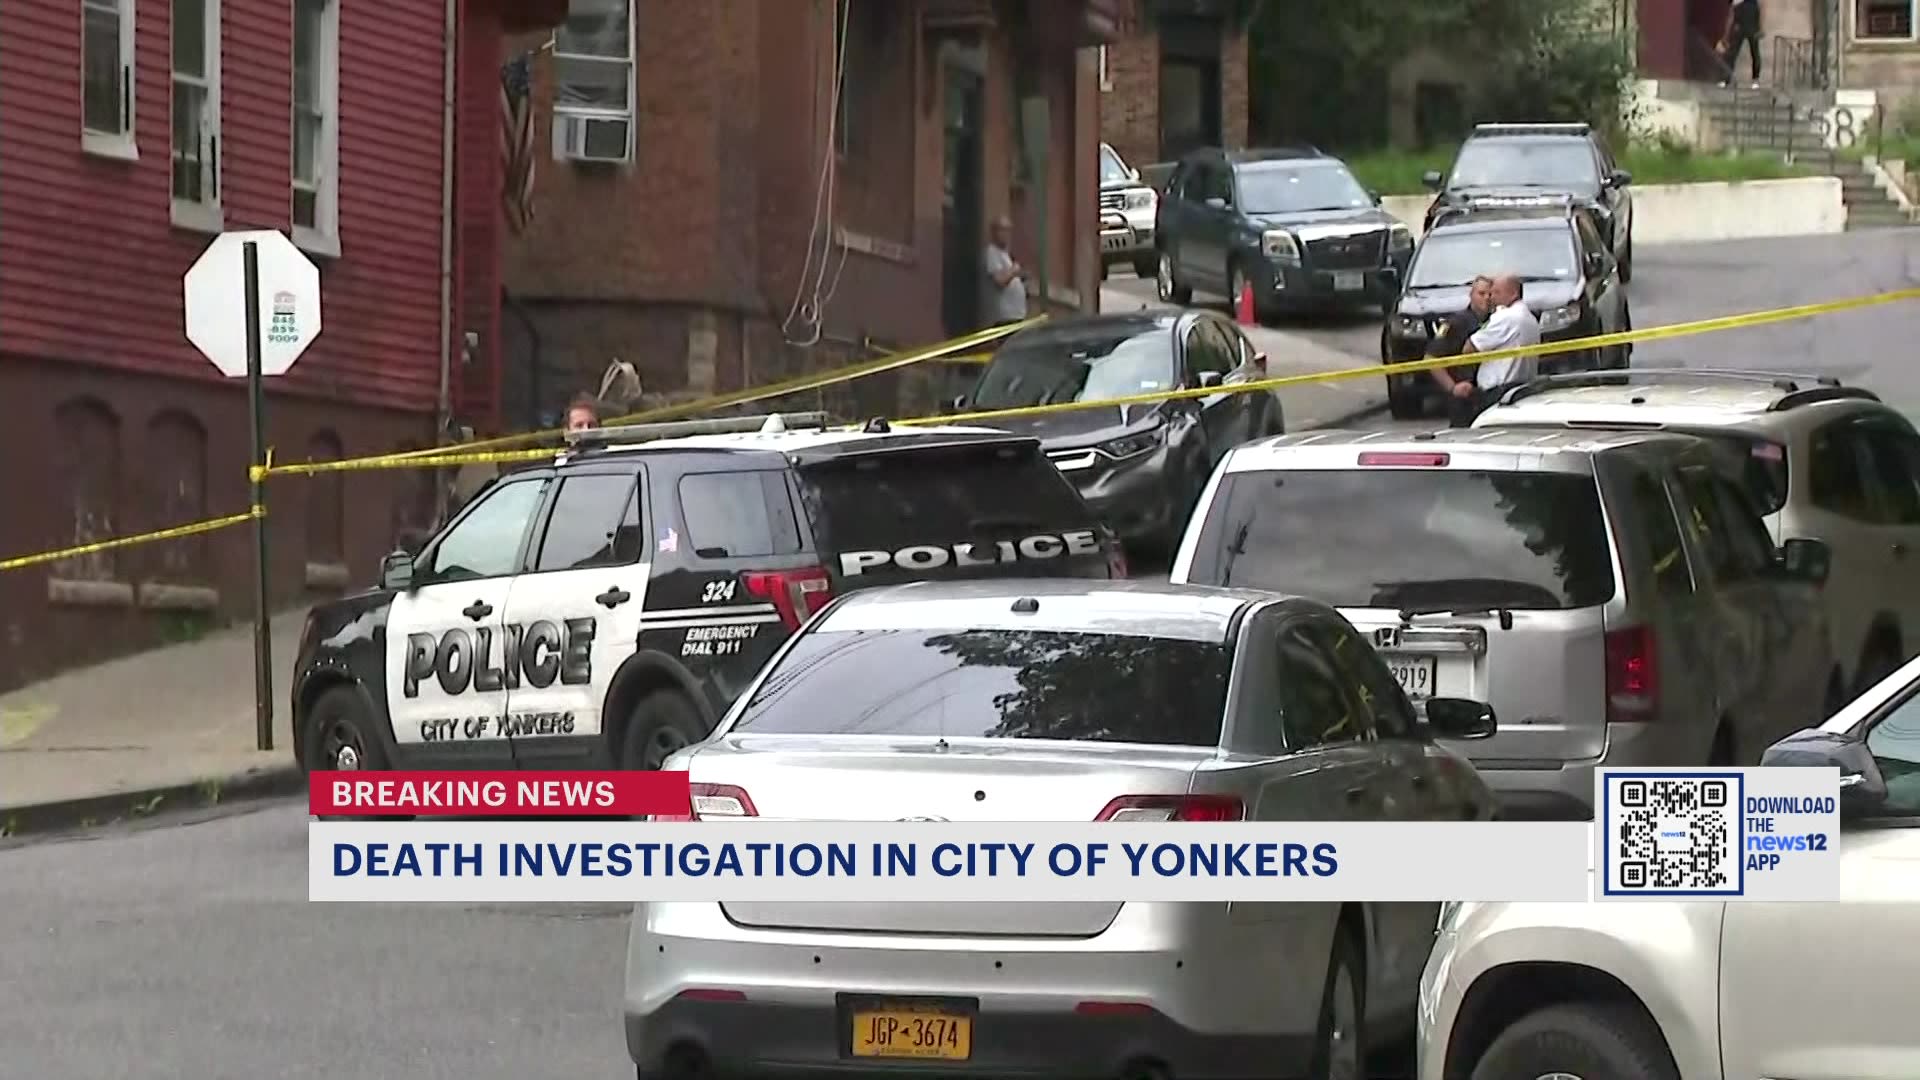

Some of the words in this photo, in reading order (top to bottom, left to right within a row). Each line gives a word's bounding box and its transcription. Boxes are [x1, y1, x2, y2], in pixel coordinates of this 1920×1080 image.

[839, 529, 1100, 576] POLICE
[701, 580, 736, 603] 324
[685, 624, 760, 641] EMERGENCY
[403, 616, 597, 698] POLICE
[681, 640, 714, 657] DIAL
[716, 640, 741, 656] 911
[420, 717, 459, 741] CITY
[463, 716, 489, 739] OF
[495, 711, 576, 737] YONKERS
